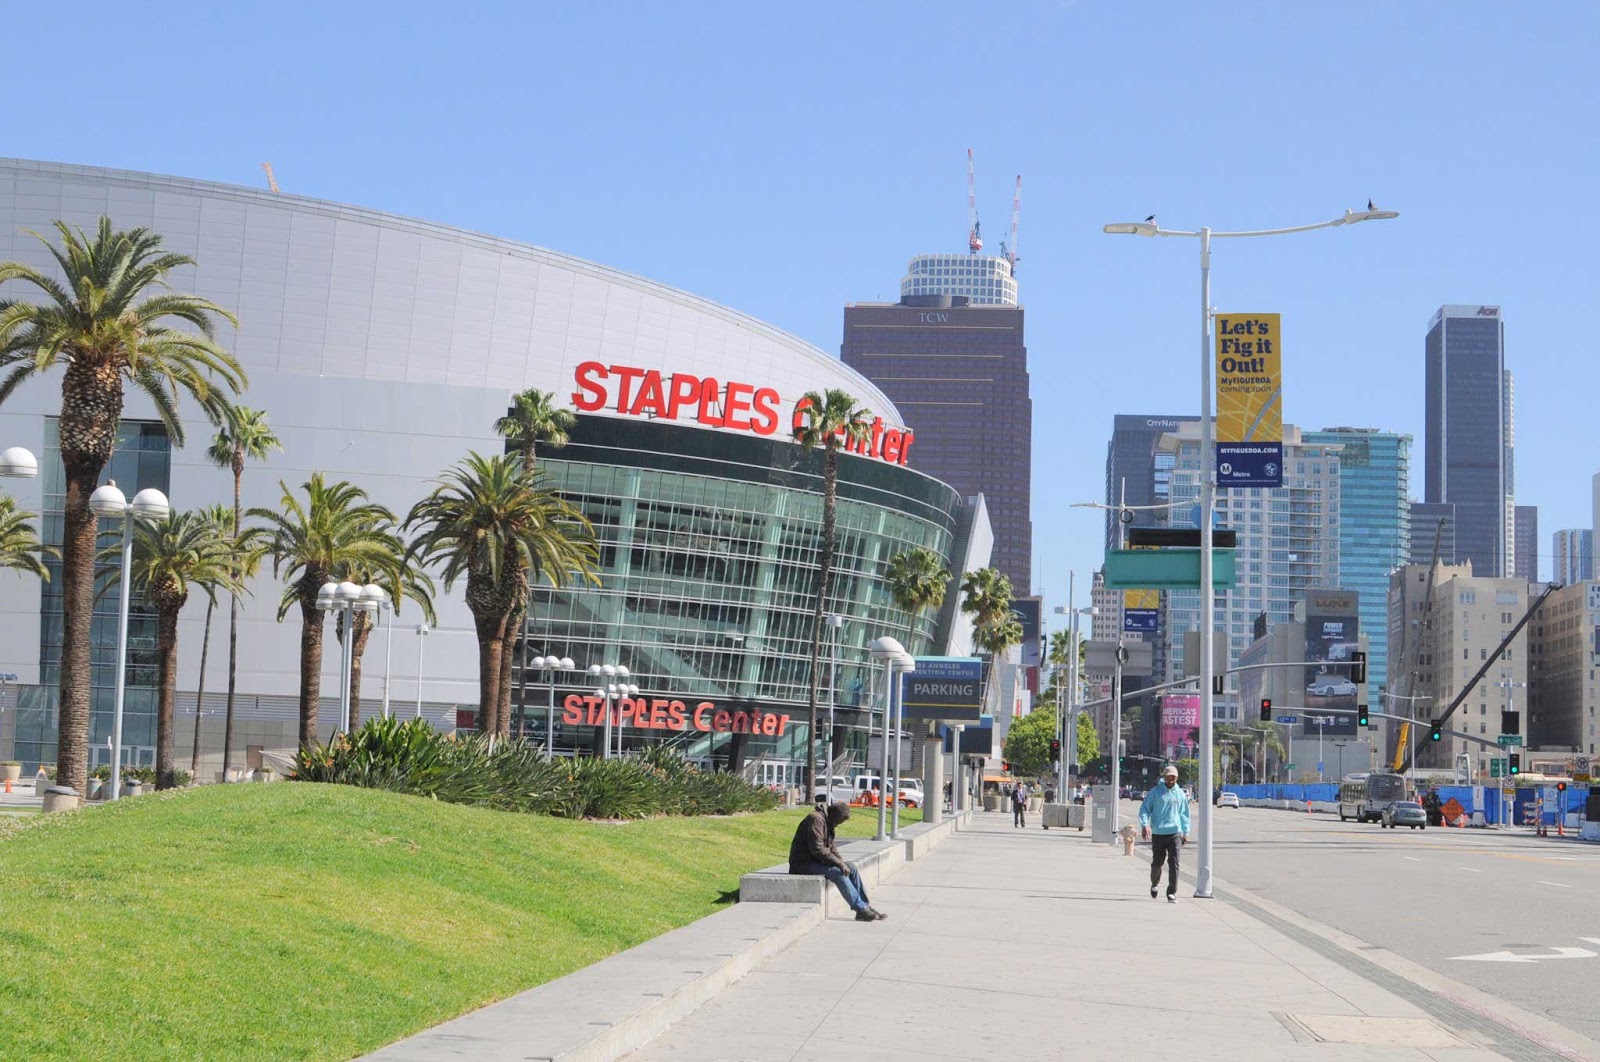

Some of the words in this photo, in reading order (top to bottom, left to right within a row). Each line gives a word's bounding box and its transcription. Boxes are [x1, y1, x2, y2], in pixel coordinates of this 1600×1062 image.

[918, 312, 949, 323] TCW
[1220, 319, 1269, 335] Let's
[1220, 338, 1253, 357] Fig
[1256, 337, 1272, 354] it
[1221, 357, 1265, 373] Out!
[1221, 377, 1271, 385] MyFIGUEROA
[571, 361, 781, 435] STAPLES
[914, 683, 973, 696] PARKING
[562, 694, 686, 731] STAPLES
[693, 702, 790, 737] Center
